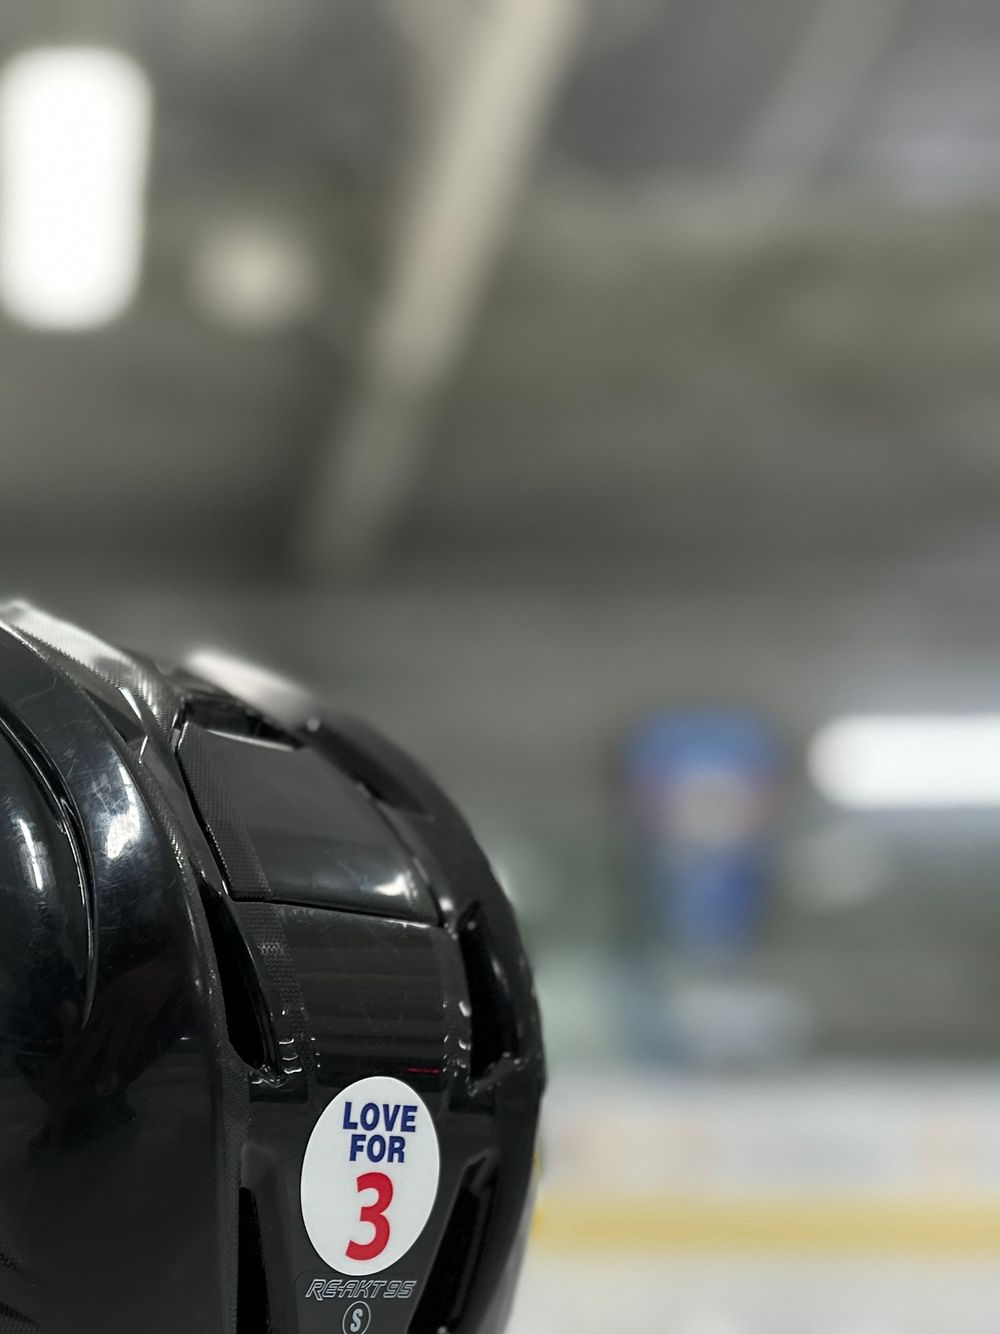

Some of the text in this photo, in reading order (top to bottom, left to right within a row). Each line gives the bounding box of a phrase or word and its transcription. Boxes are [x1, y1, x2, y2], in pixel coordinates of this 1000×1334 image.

[343, 1102, 418, 1133] LOVE
[349, 1134, 406, 1163] FOR
[345, 1171, 394, 1262] 3
[383, 1280, 417, 1299] 95
[350, 1308, 363, 1333] S
